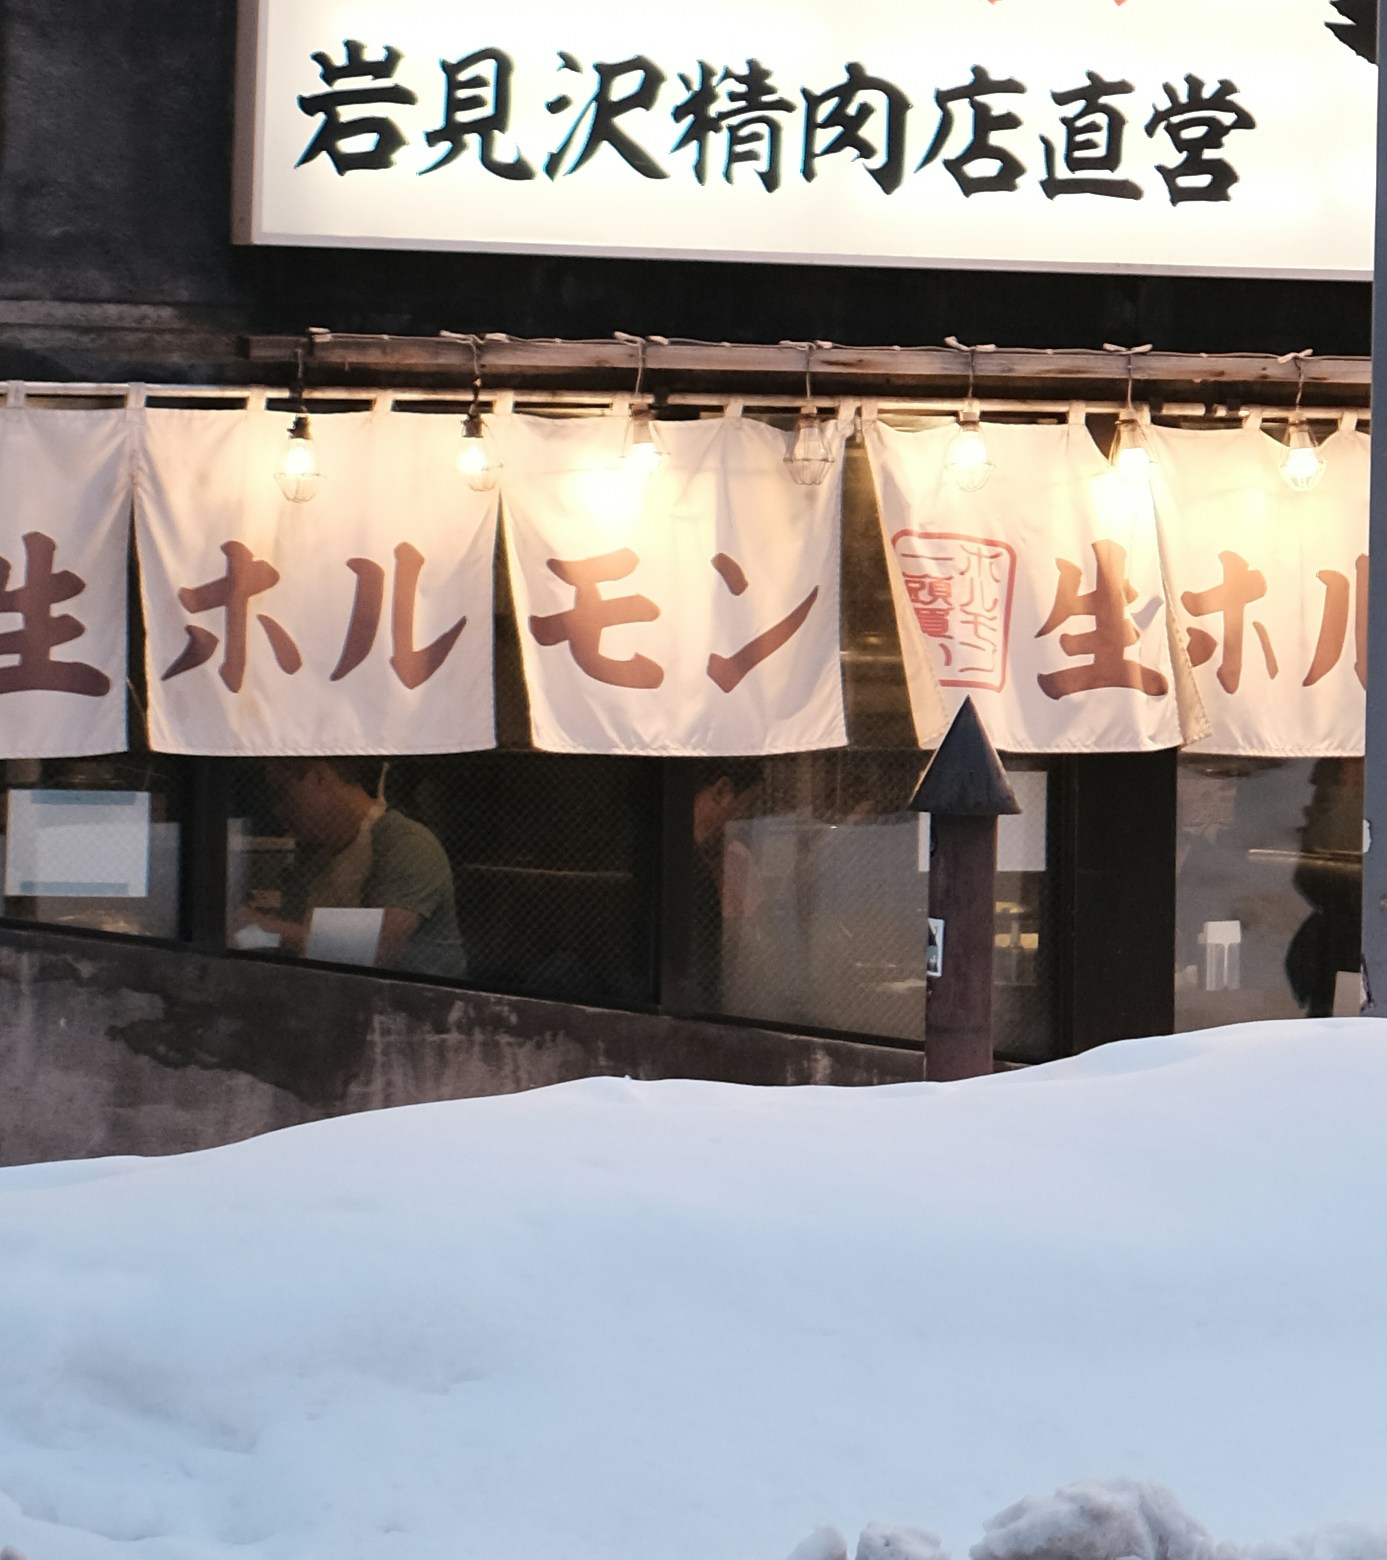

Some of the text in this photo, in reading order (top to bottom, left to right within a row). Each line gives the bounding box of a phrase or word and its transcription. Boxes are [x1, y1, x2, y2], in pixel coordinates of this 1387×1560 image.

[294, 37, 1257, 207] 岩見沢精肉店直営
[0, 531, 819, 698] 生ホルモン
